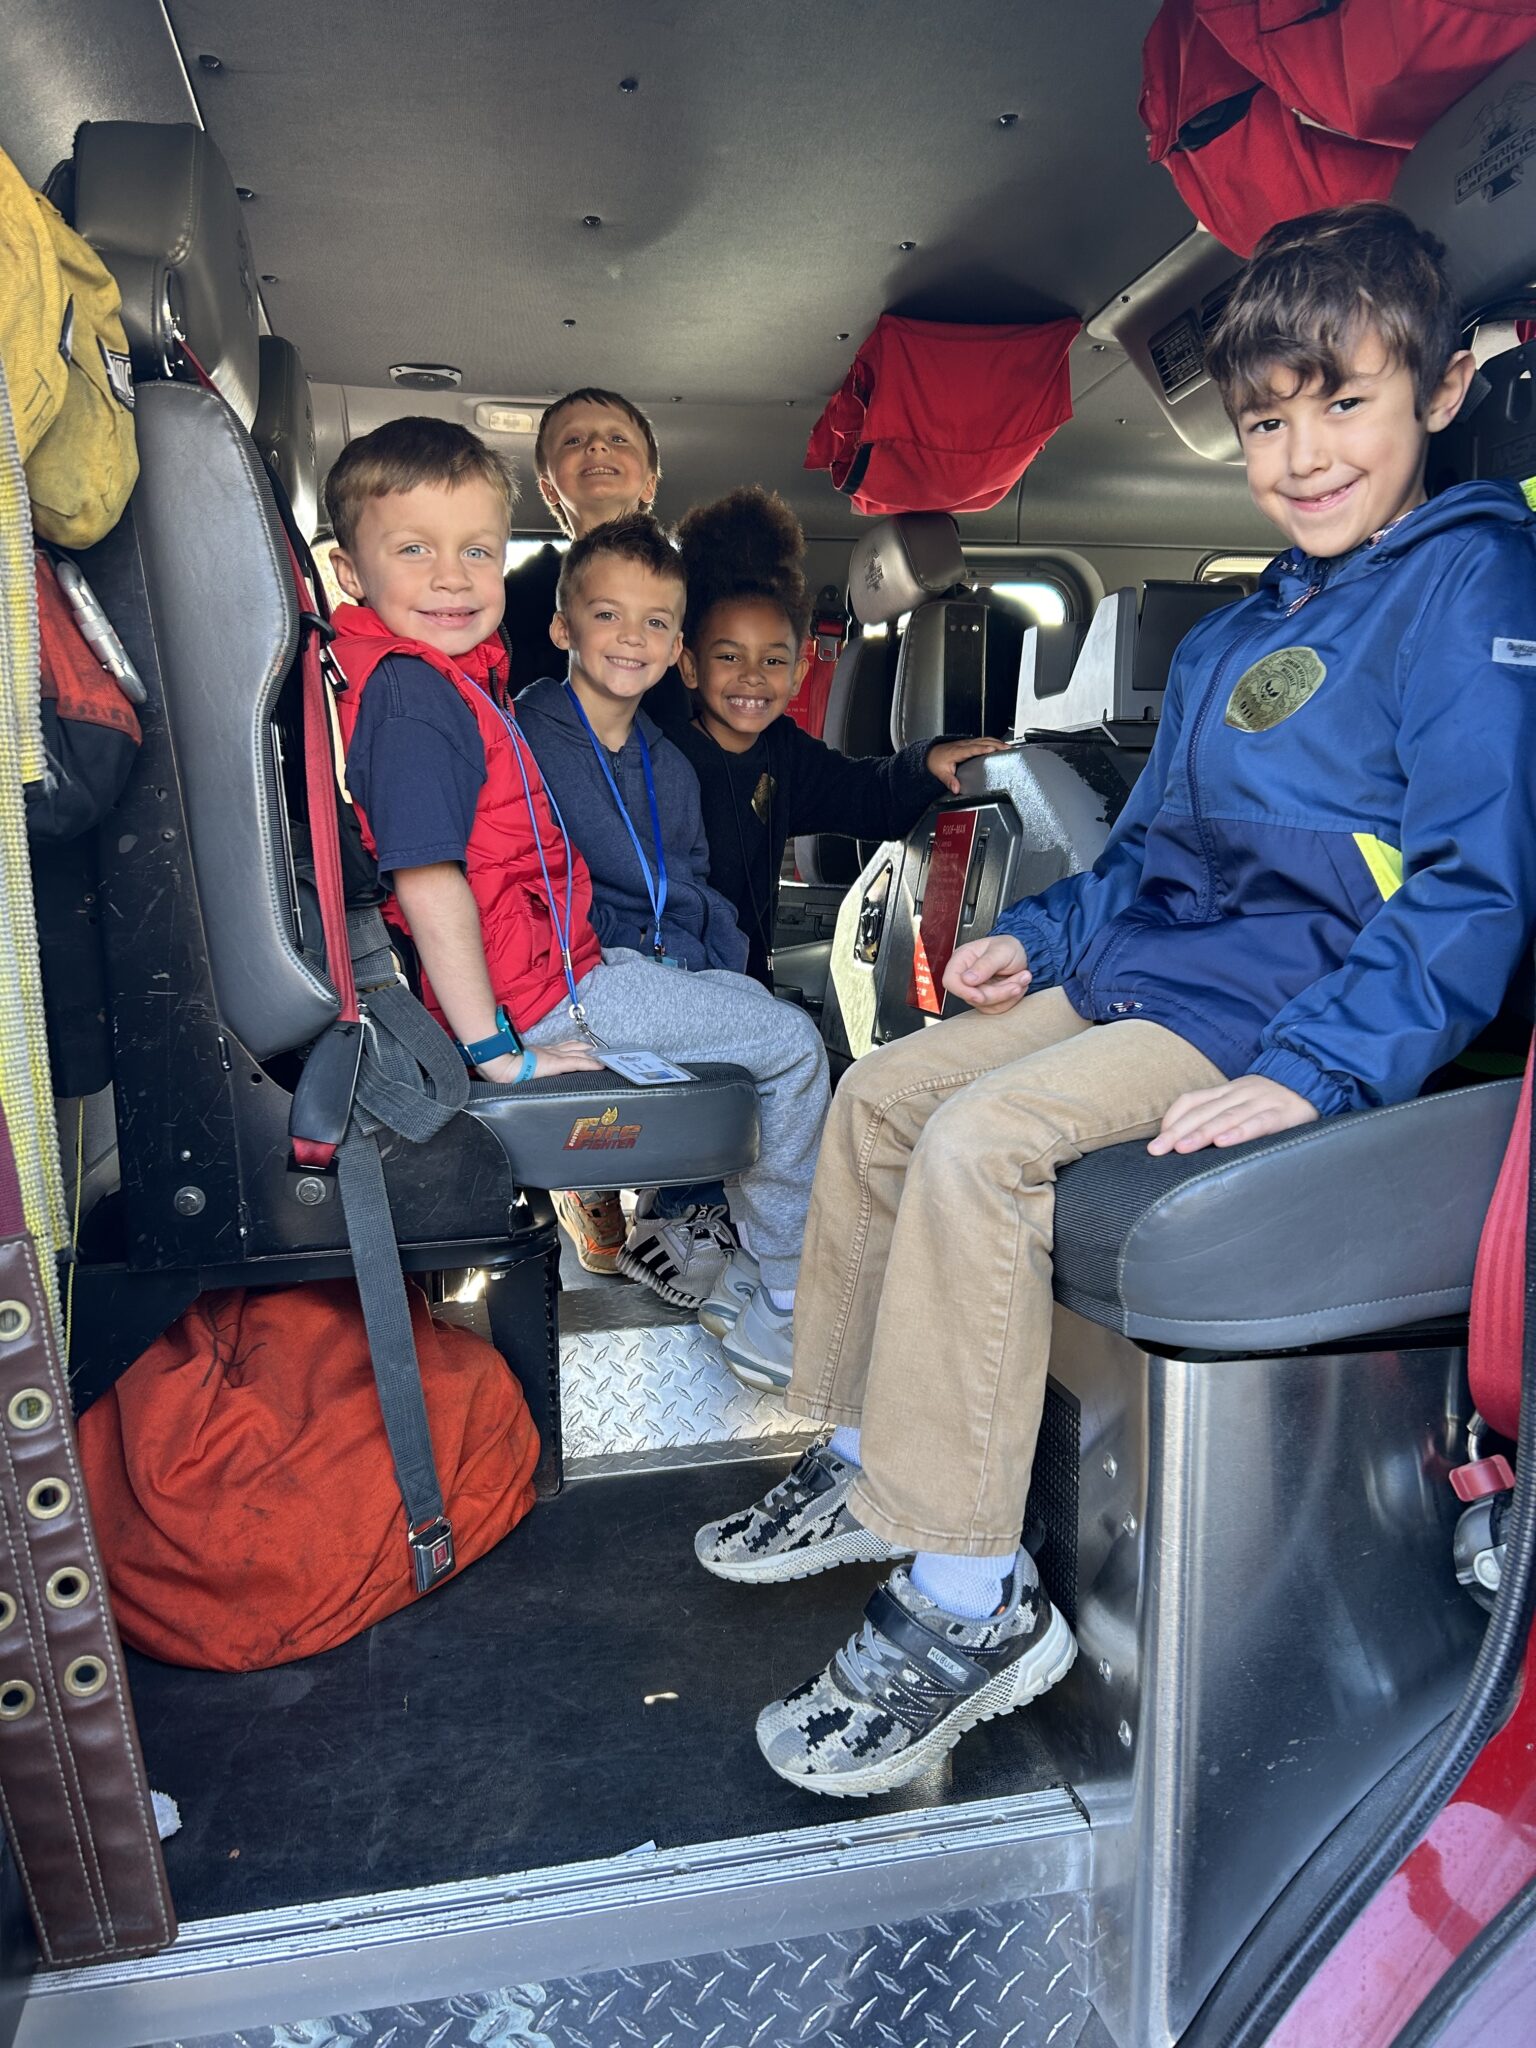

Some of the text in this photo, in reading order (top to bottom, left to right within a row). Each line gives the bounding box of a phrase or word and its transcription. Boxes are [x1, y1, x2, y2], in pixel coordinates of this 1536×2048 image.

[1297, 667, 1306, 689] OFFICER
[579, 1138, 637, 1151] FIGHTER
[929, 1650, 955, 1671] KUBUA
